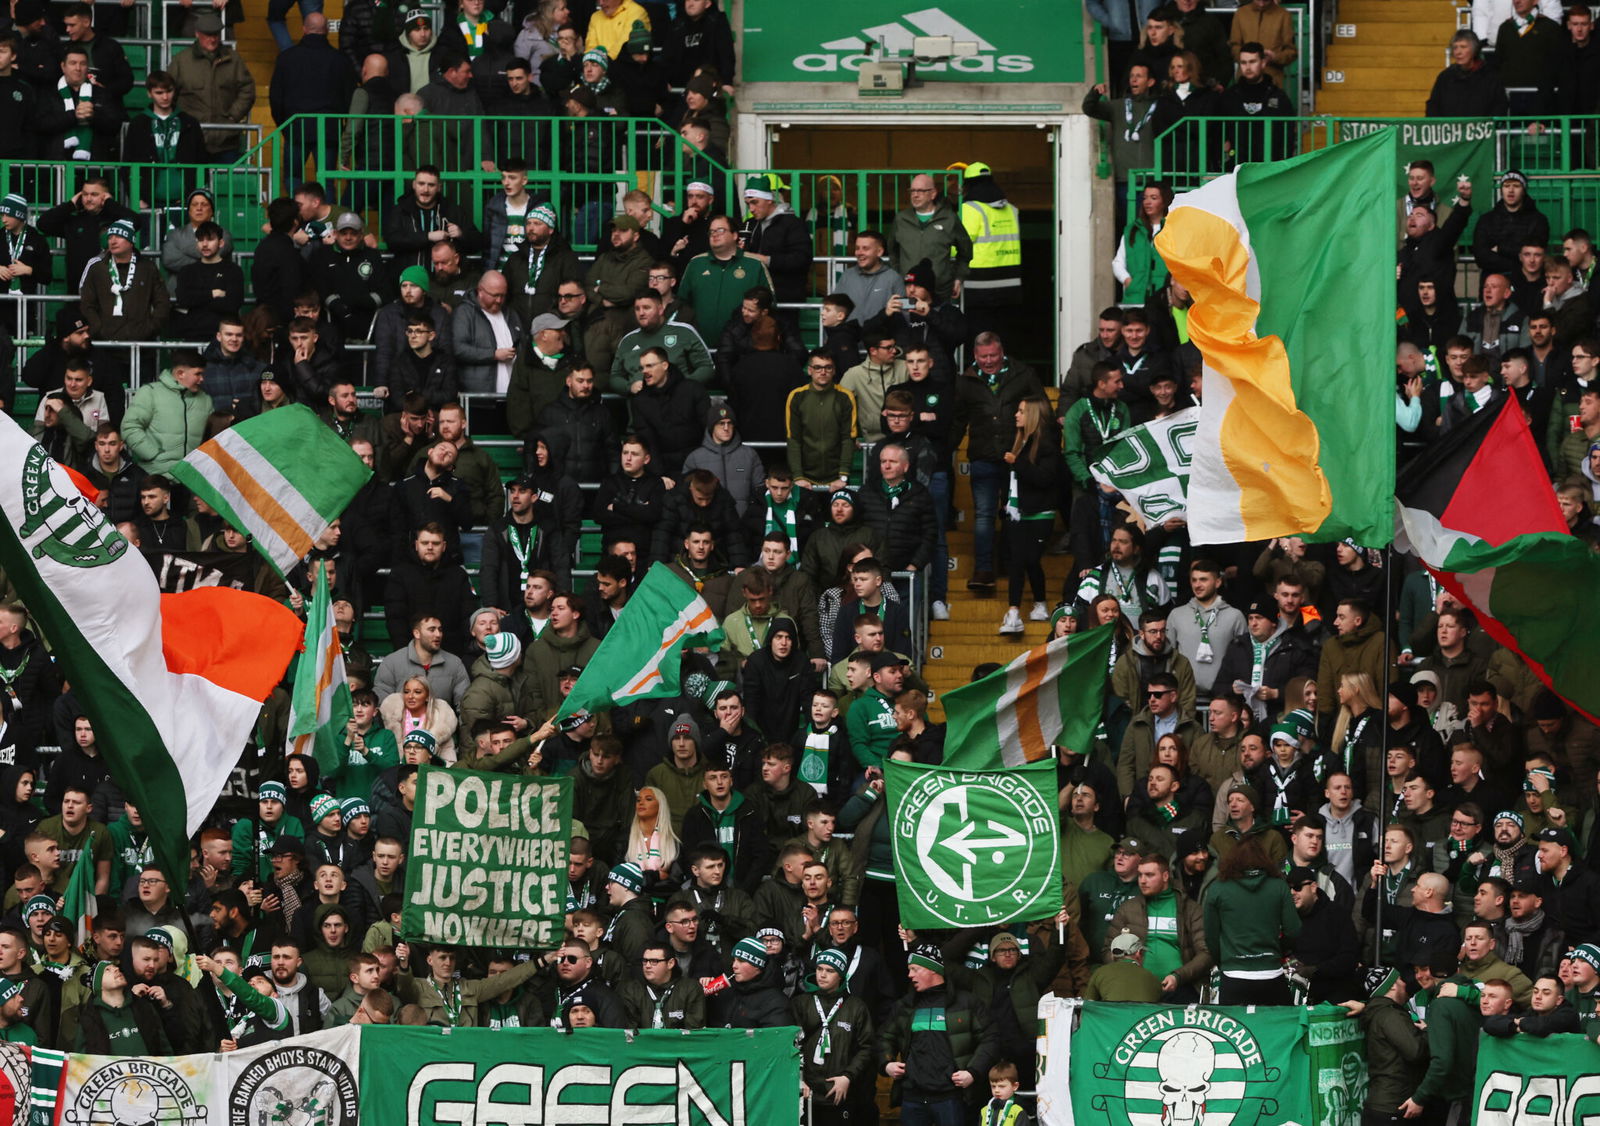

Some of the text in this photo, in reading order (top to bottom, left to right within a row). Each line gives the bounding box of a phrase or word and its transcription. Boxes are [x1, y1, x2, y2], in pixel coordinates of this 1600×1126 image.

[1337, 25, 1355, 36] EE
[793, 48, 1034, 73] adas
[1325, 71, 1345, 82] DD
[1403, 123, 1462, 146] PLOUGH
[26, 457, 43, 516] GREEN
[931, 646, 942, 659] Q
[424, 771, 561, 835] POLICE
[901, 772, 1050, 839] GREEN BRIGADE
[413, 828, 567, 869] EVERYWHERE
[411, 863, 560, 916] JUSTICE
[423, 911, 553, 948] NOWHERE
[1115, 1009, 1262, 1069] GREEN BRIGADE
[79, 1062, 193, 1110] GREEN BRIGADE
[234, 1064, 267, 1107] BANNED
[265, 1050, 305, 1072] BHOYS
[307, 1051, 341, 1076] STAND
[346, 1101, 357, 1118] US
